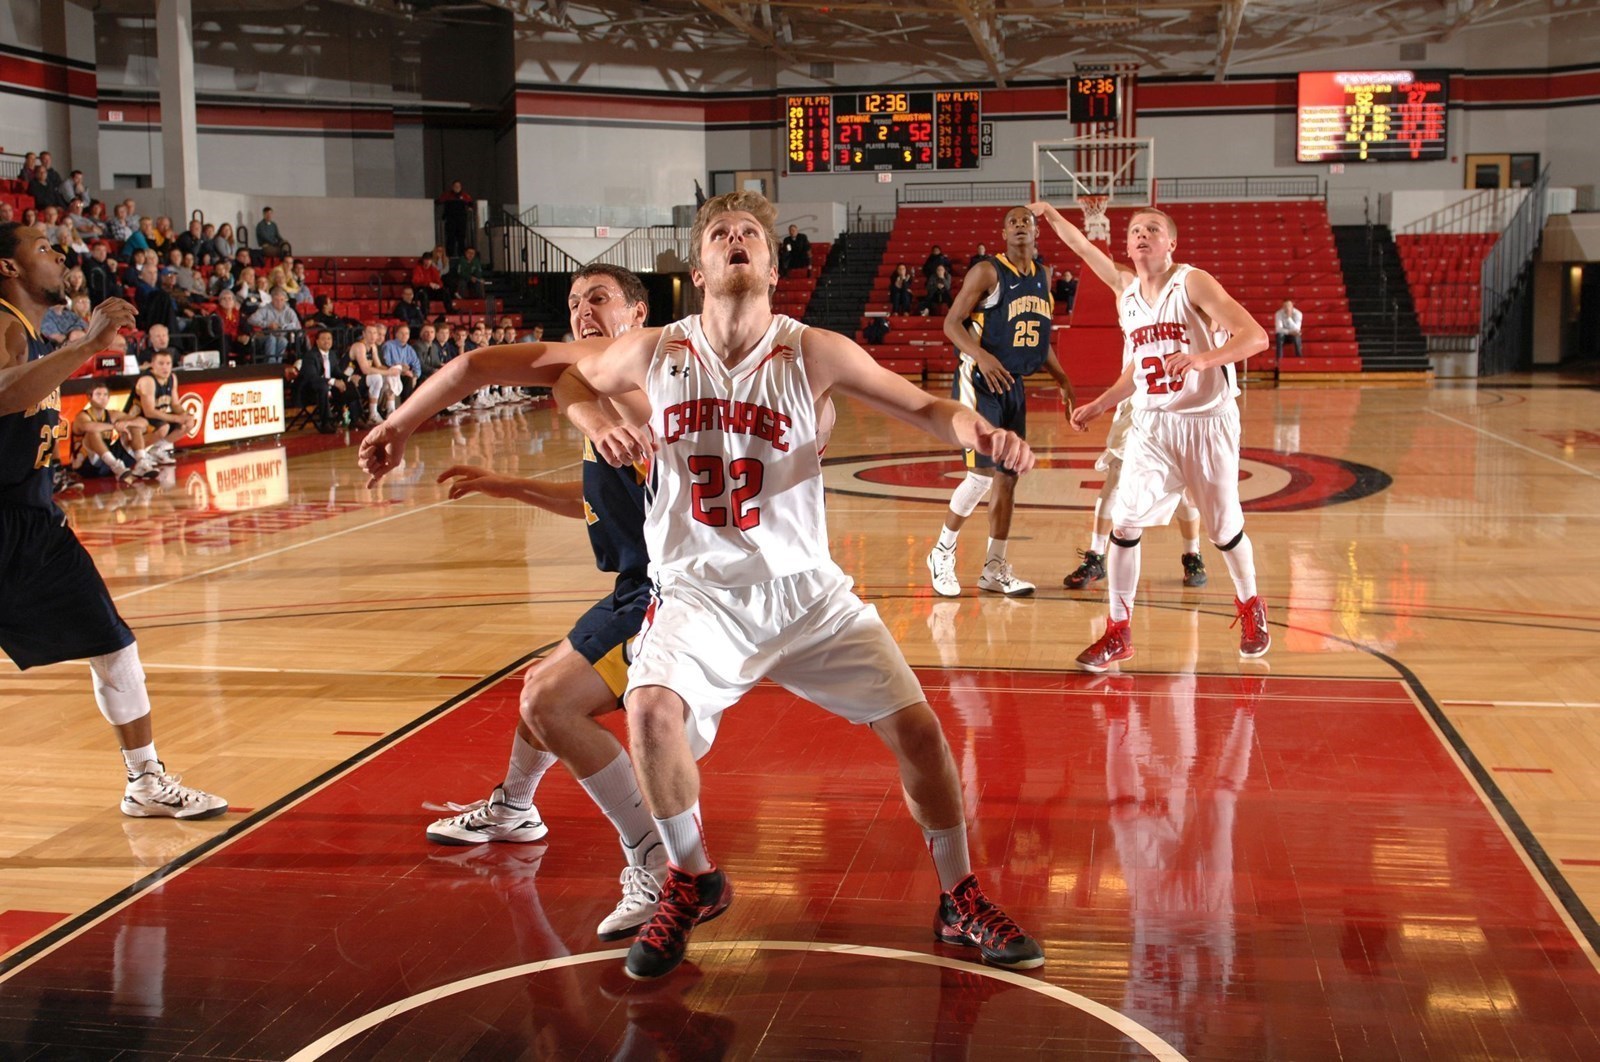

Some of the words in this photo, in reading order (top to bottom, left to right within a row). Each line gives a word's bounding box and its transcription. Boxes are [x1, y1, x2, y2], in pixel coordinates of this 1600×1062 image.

[1078, 79, 1114, 94] 12:36
[865, 94, 907, 112] 12:36
[964, 92, 979, 101] PTS
[790, 107, 804, 118] 20
[790, 117, 804, 129] 21
[790, 129, 804, 140] 22
[840, 125, 862, 142] 27
[878, 126, 888, 140] 2
[909, 122, 931, 142] 52
[790, 140, 804, 150] 25
[790, 151, 804, 162] 43
[841, 149, 849, 163] 3
[854, 152, 863, 163] 2
[903, 150, 912, 162] 5
[921, 147, 931, 162] 2
[1013, 320, 1041, 347] 25
[213, 405, 280, 430] BASKETBALL
[663, 397, 792, 453] CARTHAGE
[687, 455, 764, 531] 22
